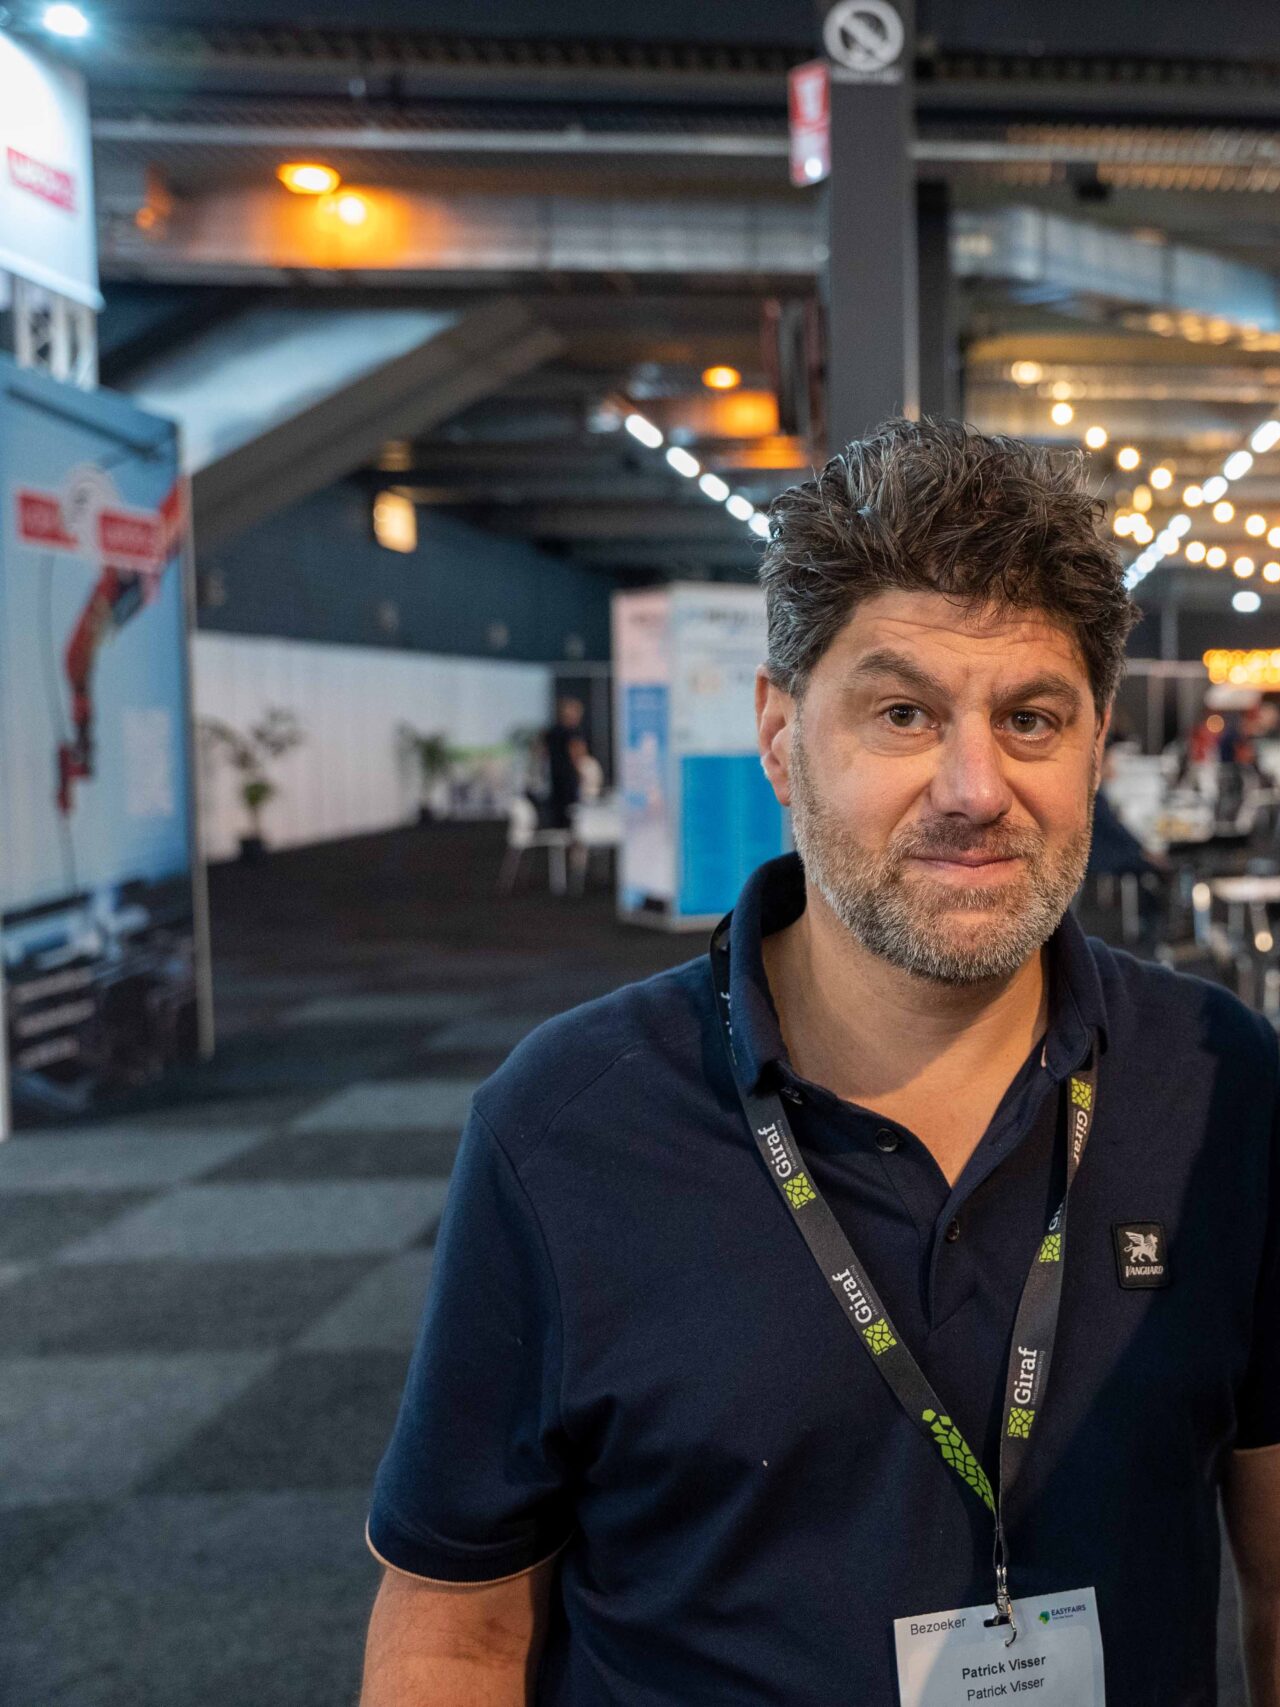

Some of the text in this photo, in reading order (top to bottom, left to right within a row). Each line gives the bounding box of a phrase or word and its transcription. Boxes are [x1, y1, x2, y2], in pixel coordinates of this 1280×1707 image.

[757, 1122, 792, 1178] Giraf
[1125, 1265, 1164, 1278] VANGUARD
[831, 1268, 873, 1324] Giraf
[1013, 1345, 1038, 1405] Giraf
[1051, 1604, 1086, 1616] EASYFAIRS
[910, 1617, 967, 1636] Bezoeker
[961, 1656, 1046, 1680] Patrick Visser
[967, 1678, 1045, 1701] Patrick Visser
